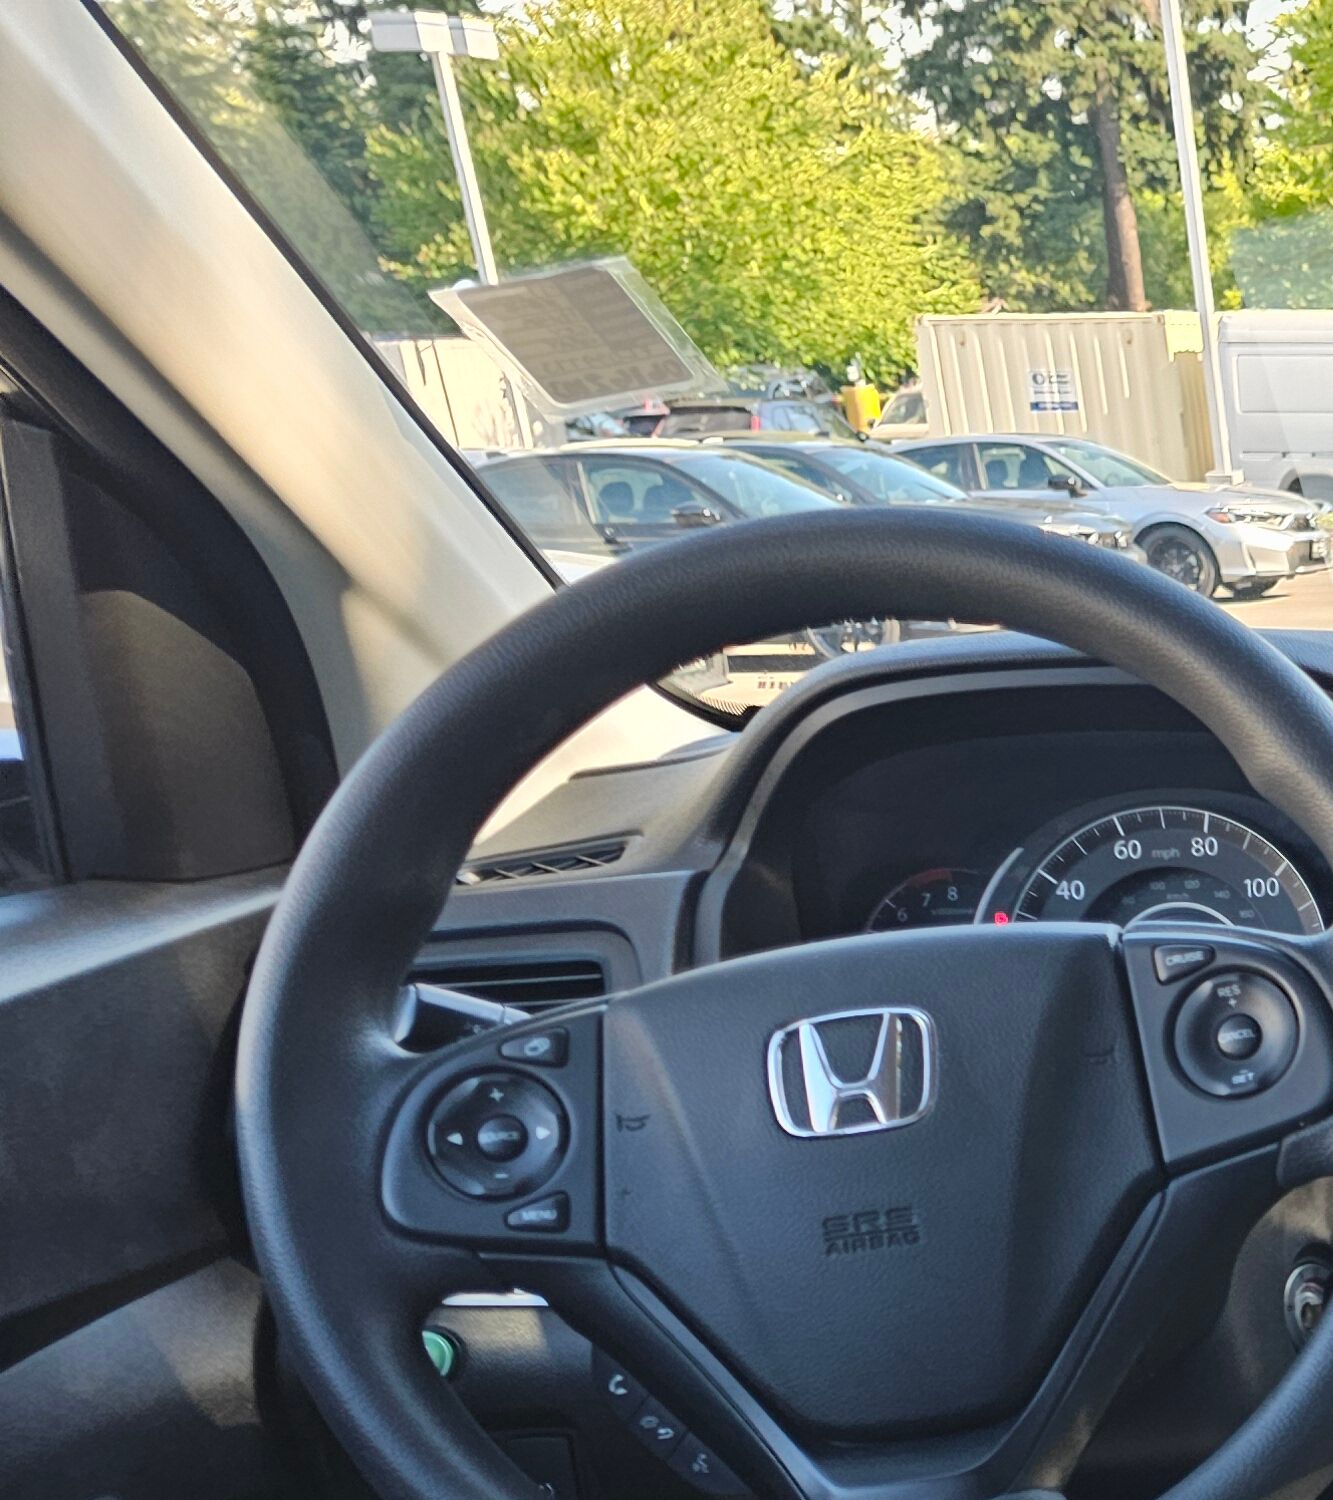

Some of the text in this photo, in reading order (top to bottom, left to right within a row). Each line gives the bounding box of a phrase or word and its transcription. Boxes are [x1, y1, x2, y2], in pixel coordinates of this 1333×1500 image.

[1113, 836, 1219, 861] 60 mph 80
[947, 886, 959, 901] 8
[1055, 879, 1085, 901] 40
[1244, 877, 1280, 898] 100
[921, 892, 931, 907] 7
